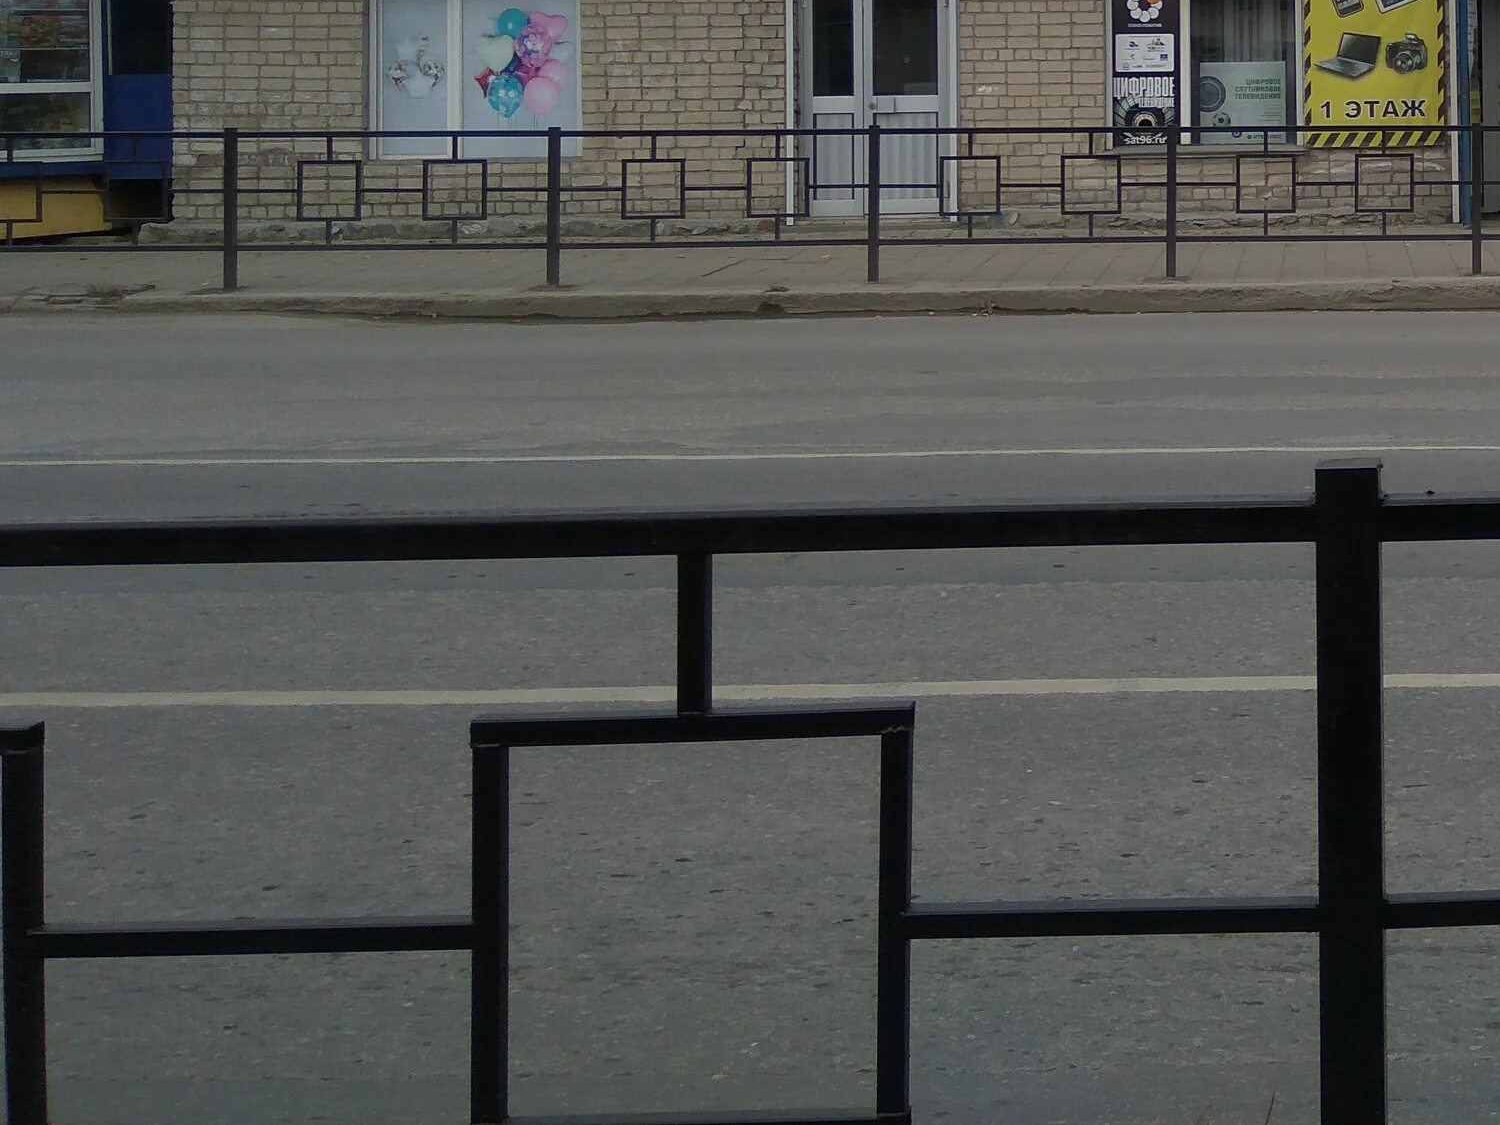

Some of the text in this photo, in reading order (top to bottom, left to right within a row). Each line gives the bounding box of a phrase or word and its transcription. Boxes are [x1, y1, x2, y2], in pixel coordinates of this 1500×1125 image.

[1113, 76, 1175, 100] ЦИФРОВОЕ
[1320, 99, 1426, 119] 1 ЭТАЖ
[1123, 135, 1168, 145] sat96.ru
